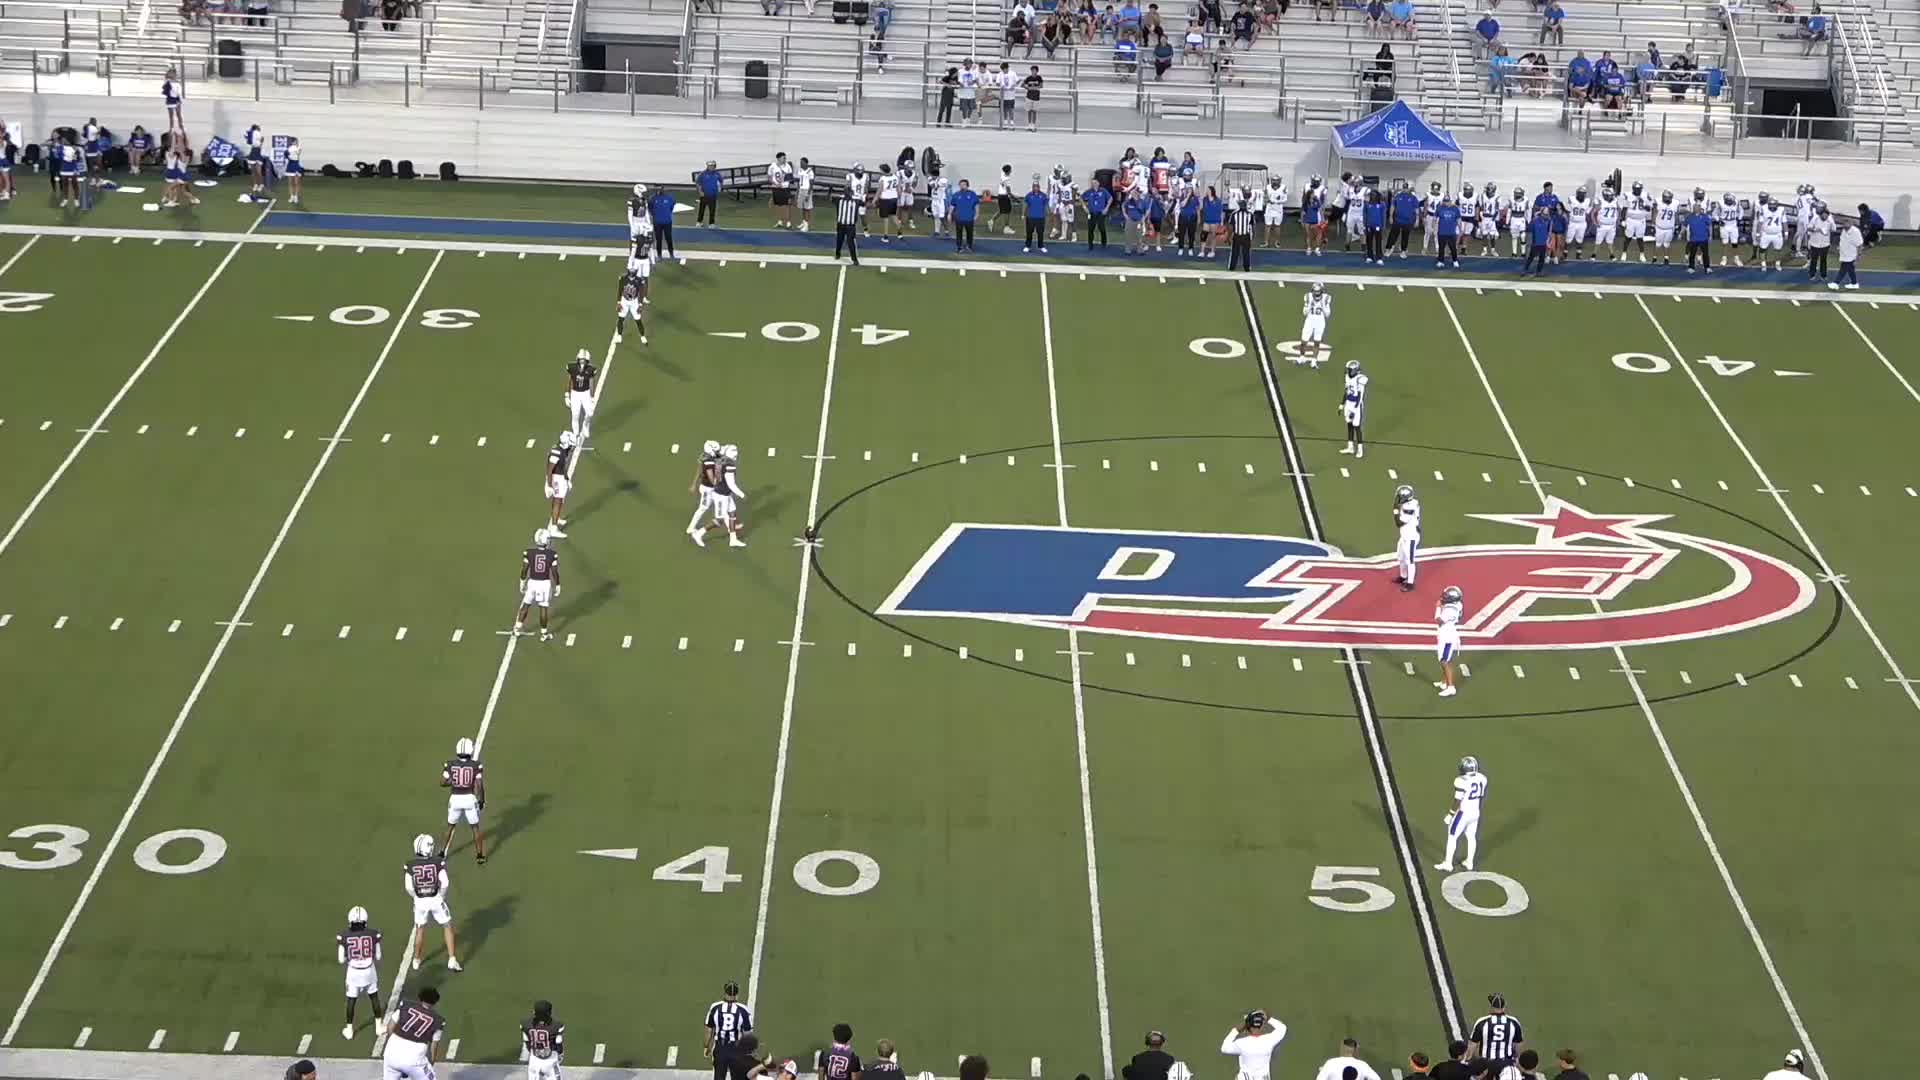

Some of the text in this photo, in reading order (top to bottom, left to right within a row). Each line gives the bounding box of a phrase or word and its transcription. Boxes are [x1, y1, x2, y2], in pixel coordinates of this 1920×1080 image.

[1389, 151, 1413, 159] SPORTS
[1461, 203, 1474, 215] 56
[1603, 207, 1615, 218] 77
[1661, 208, 1674, 221] 79
[1767, 216, 1780, 227] 74
[535, 554, 546, 573] 6
[451, 766, 474, 788] 30
[1469, 783, 1486, 800] 21
[412, 864, 438, 888] 23
[346, 936, 373, 960] 28
[402, 1007, 434, 1038] 77
[723, 1013, 735, 1031] B
[530, 1029, 550, 1048] 19
[1492, 1024, 1505, 1041] S
[827, 1055, 849, 1078] 12
